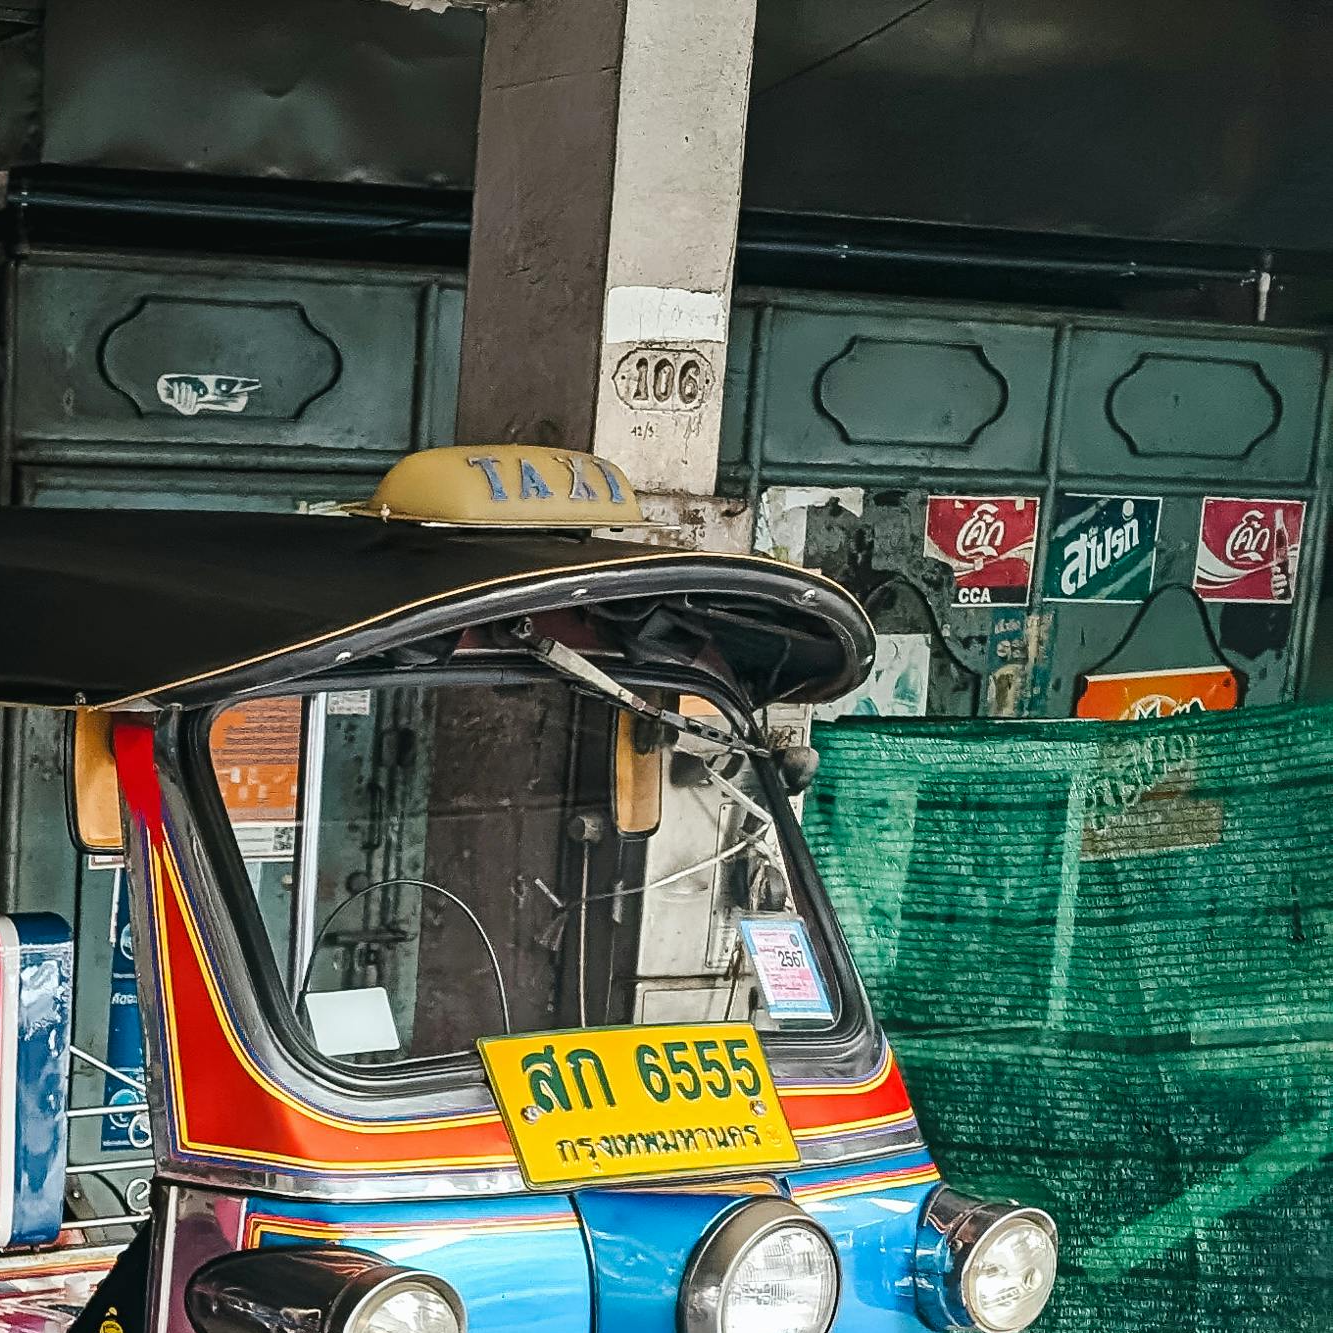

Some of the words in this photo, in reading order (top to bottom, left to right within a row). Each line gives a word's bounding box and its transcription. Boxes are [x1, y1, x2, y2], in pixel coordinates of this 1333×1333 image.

[632, 357, 701, 404] 106
[467, 455, 627, 504] TAXI
[957, 586, 992, 604] CCA
[777, 950, 806, 968] 2567
[520, 1043, 617, 1114] สก
[634, 1038, 763, 1104] 6555
[555, 1122, 763, 1173] กรุงเทพมหานคร
